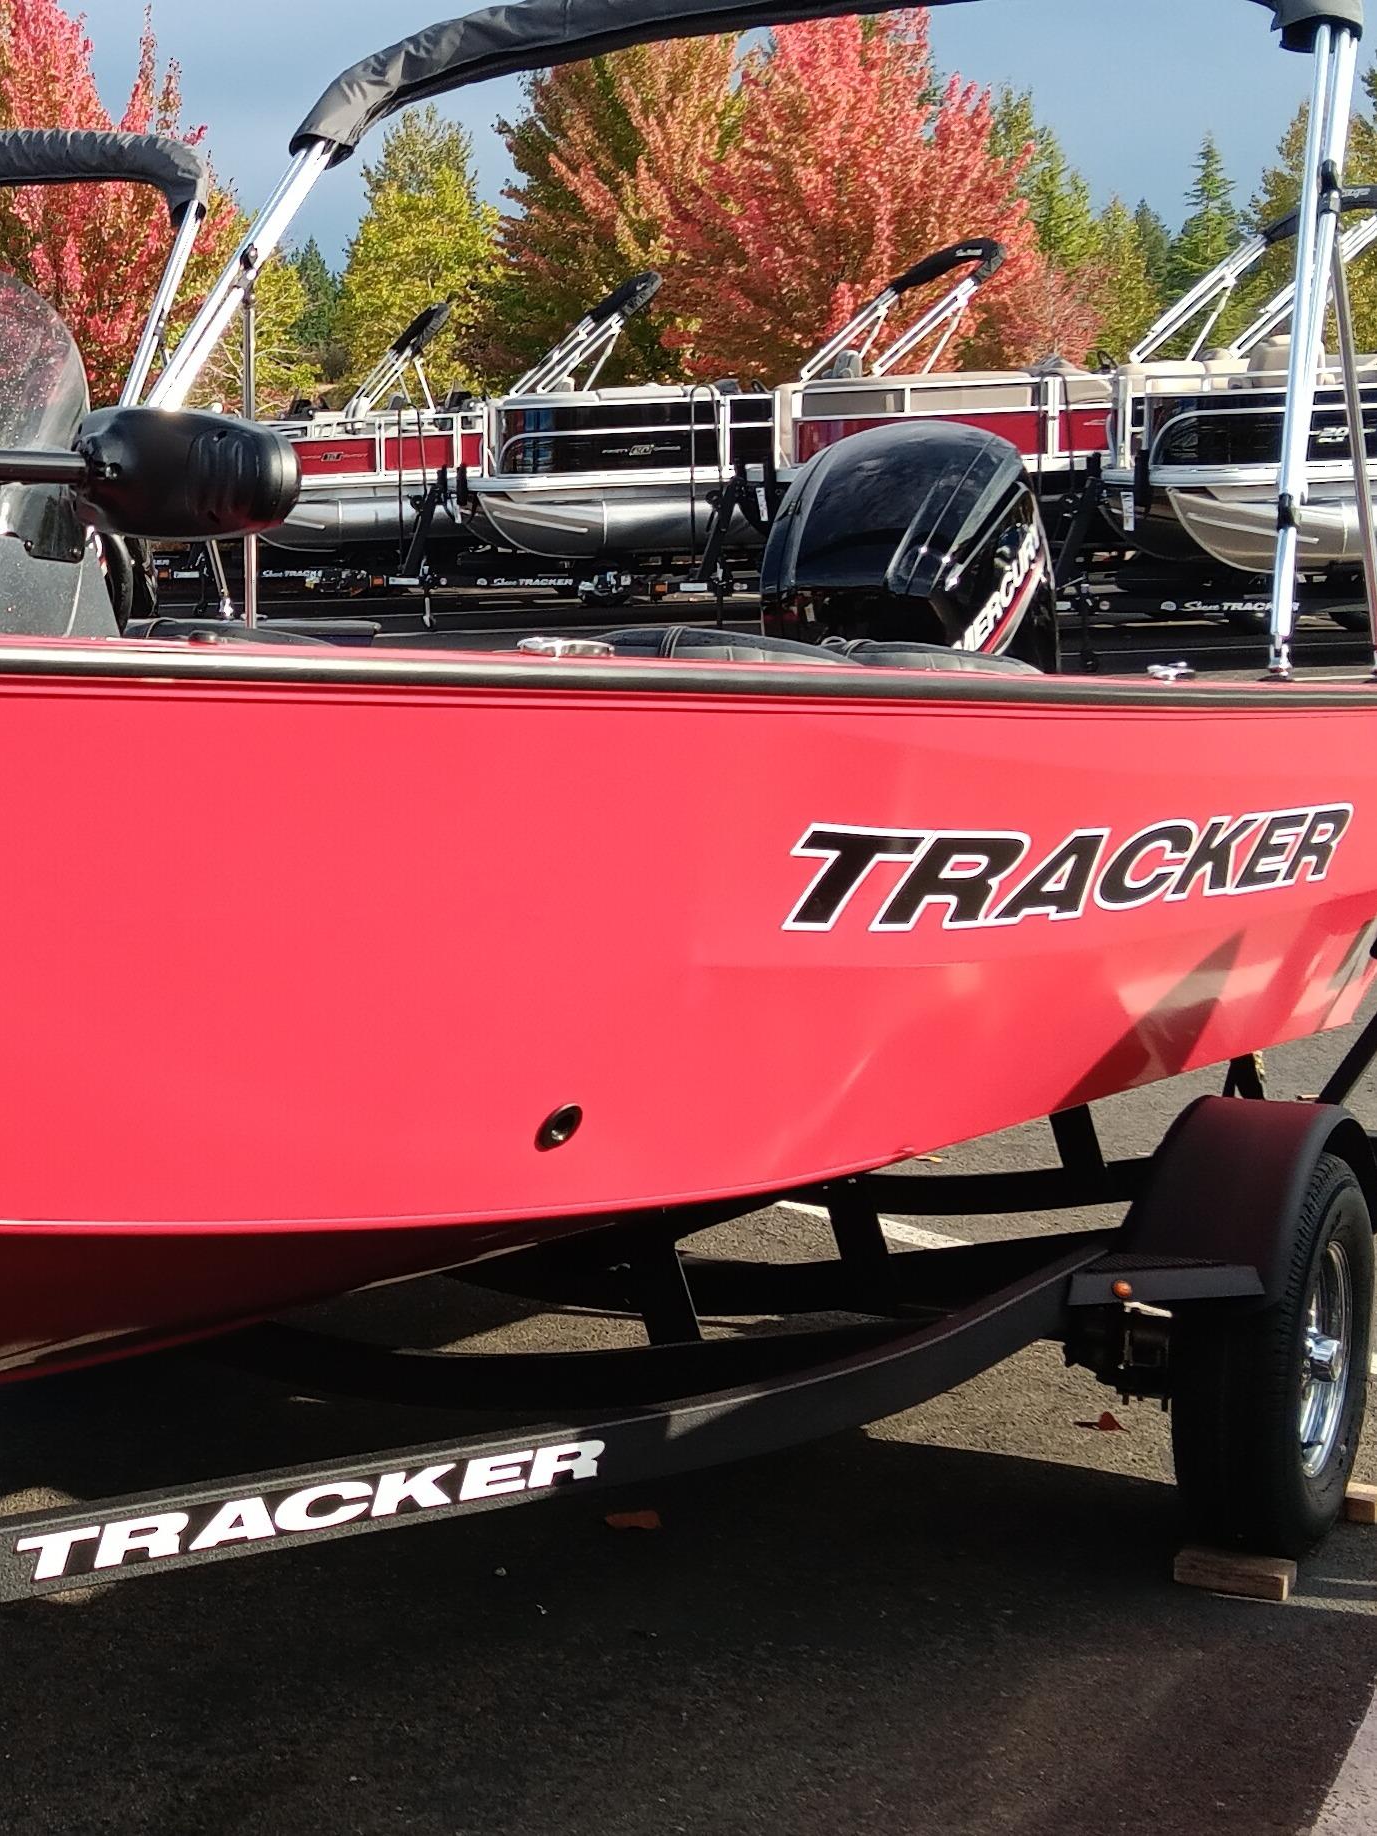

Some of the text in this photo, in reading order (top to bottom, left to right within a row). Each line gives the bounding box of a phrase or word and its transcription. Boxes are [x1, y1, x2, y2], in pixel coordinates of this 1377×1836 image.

[518, 578, 573, 586] TRACKER
[781, 802, 1355, 932] TRACKER
[15, 1440, 606, 1583] TRACKER
